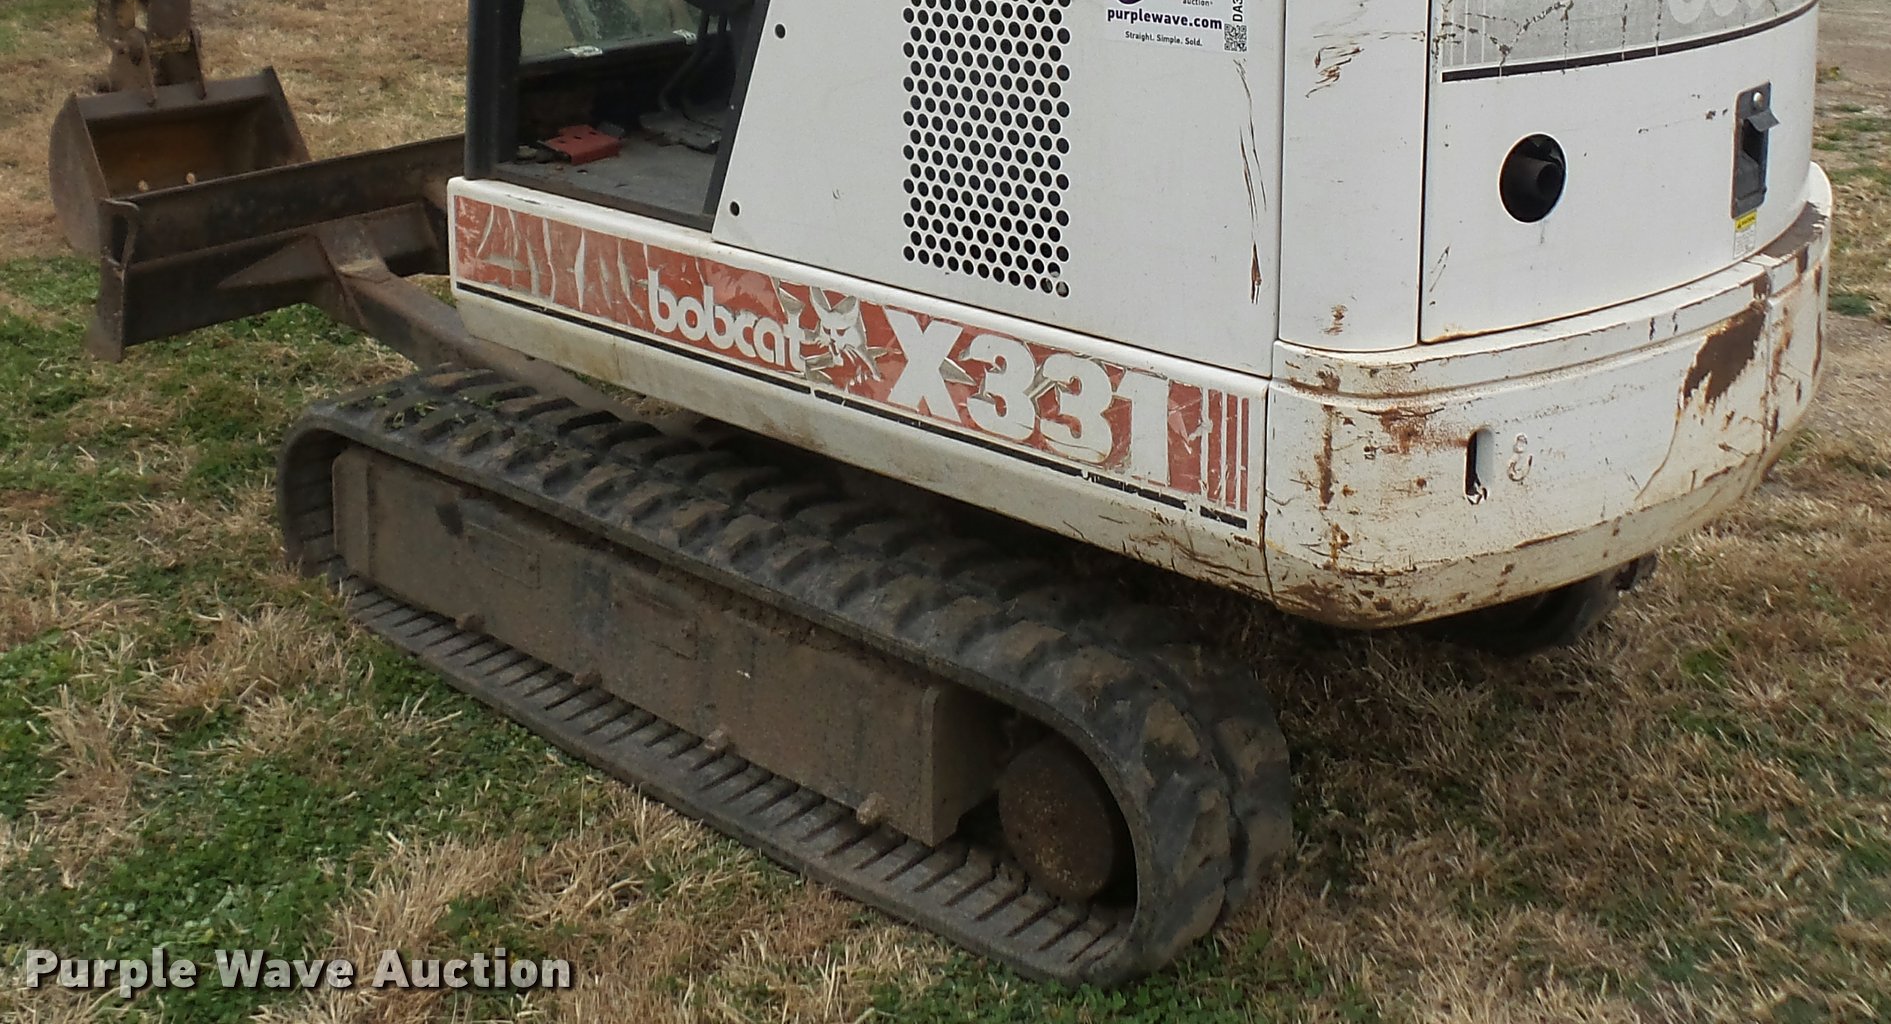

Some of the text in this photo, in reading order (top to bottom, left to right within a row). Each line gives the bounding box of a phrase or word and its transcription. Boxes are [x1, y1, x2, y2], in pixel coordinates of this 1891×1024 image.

[1107, 8, 1223, 30] purplewave.com
[1125, 31, 1203, 47] Straight. Simple. Sold.
[647, 267, 1170, 487] bobcat X331
